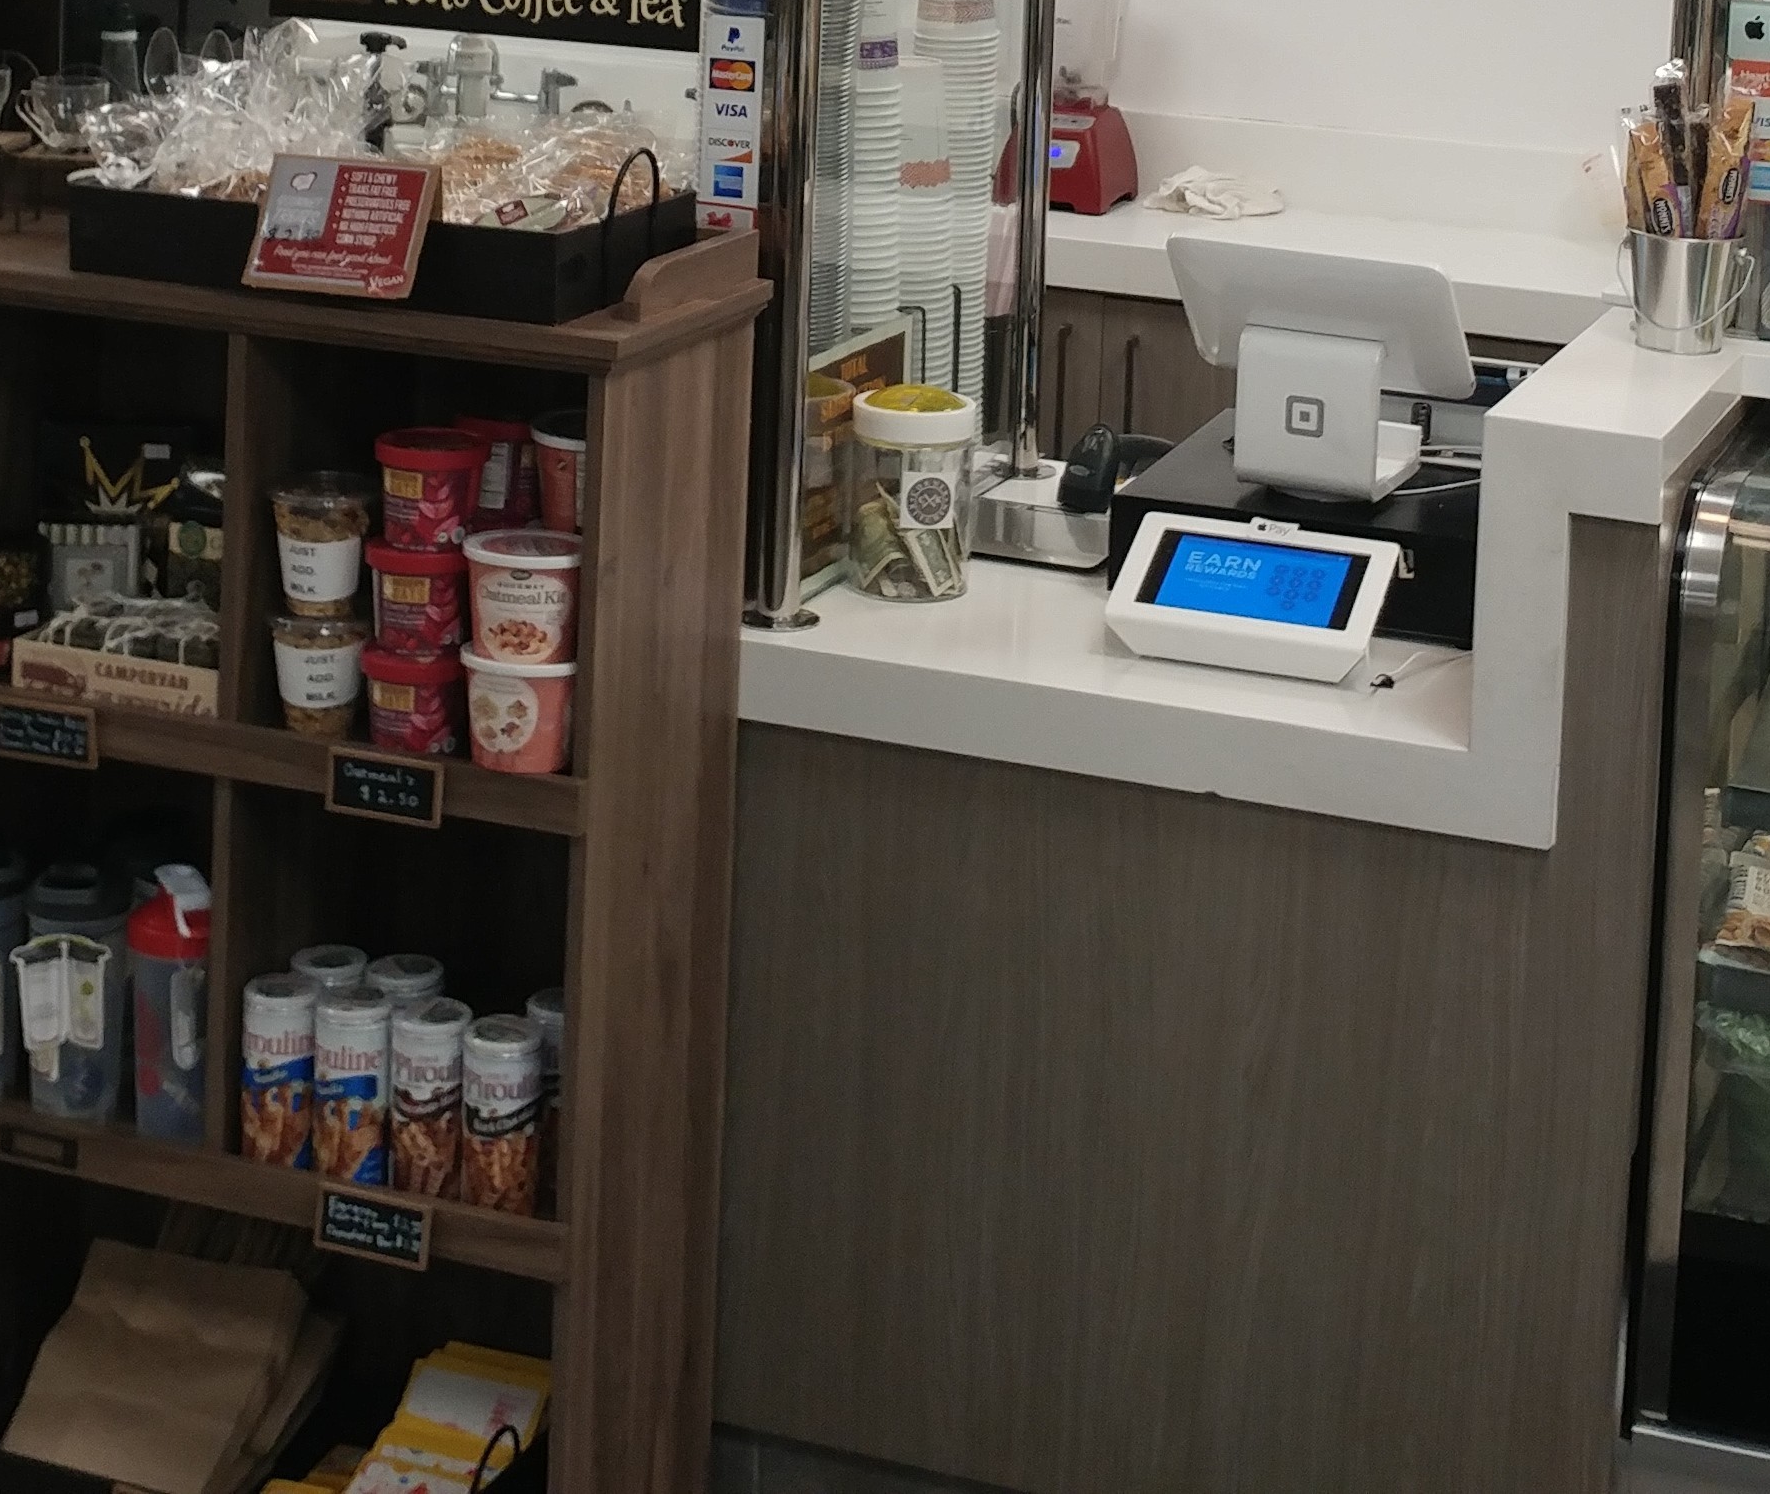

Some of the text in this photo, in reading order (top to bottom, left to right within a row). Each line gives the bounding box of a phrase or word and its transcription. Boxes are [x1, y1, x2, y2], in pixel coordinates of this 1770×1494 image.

[712, 69, 752, 81] MasterCard
[715, 103, 748, 118] VISA
[708, 137, 750, 149] DISCOVER
[369, 275, 404, 288] VEGAN
[1268, 524, 1291, 536] Pay
[1188, 551, 1261, 571] EARN
[1185, 562, 1257, 580] REWARDS
